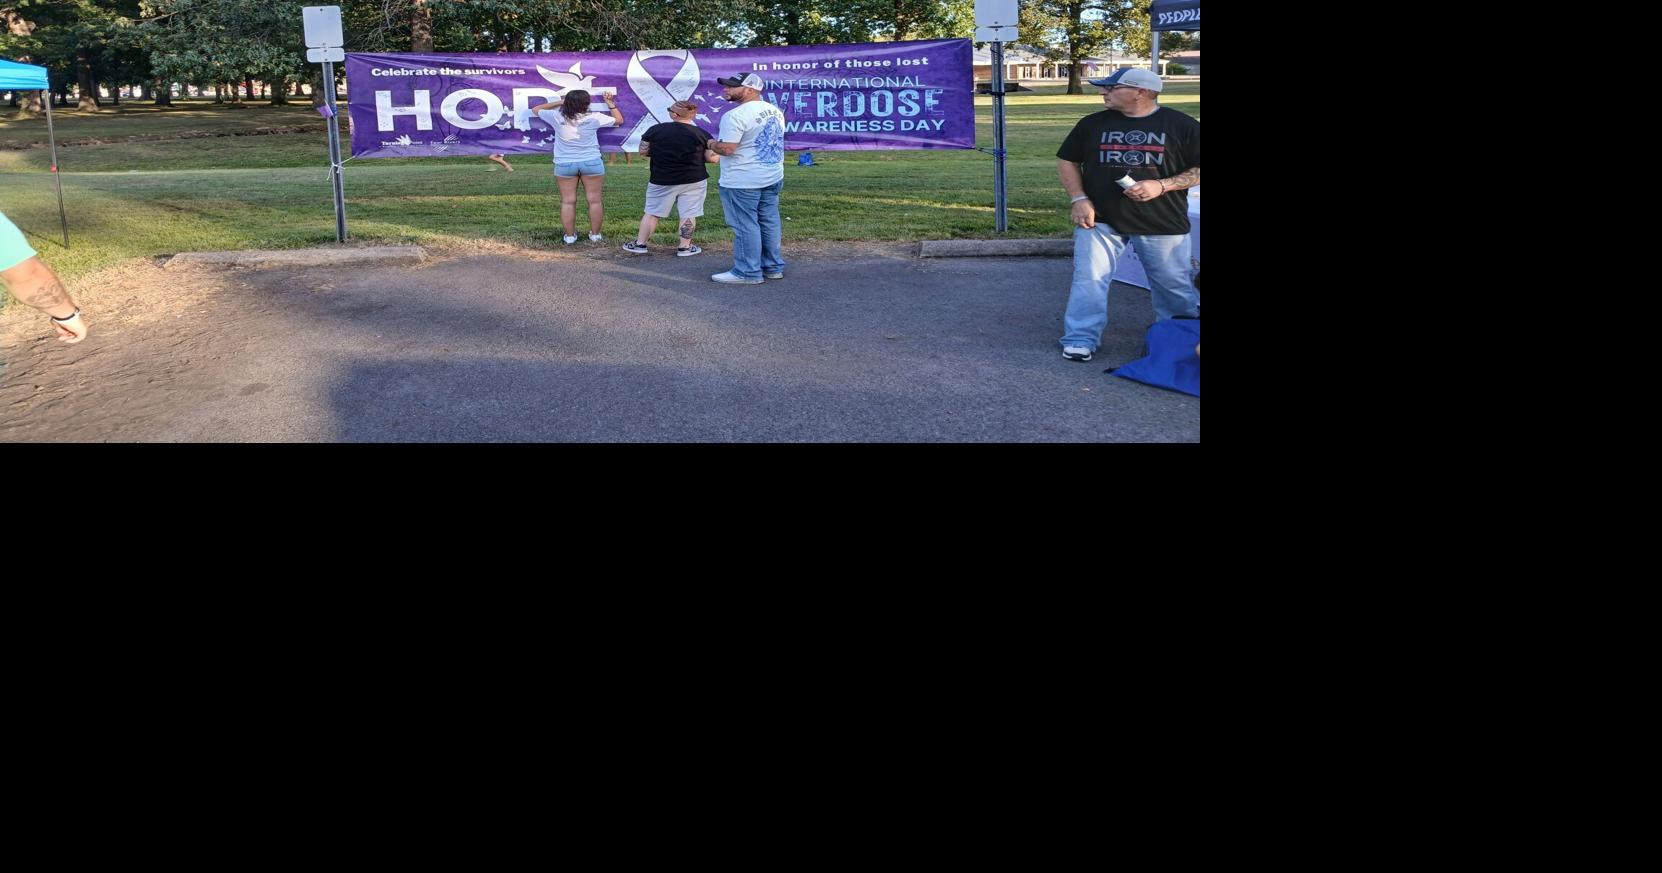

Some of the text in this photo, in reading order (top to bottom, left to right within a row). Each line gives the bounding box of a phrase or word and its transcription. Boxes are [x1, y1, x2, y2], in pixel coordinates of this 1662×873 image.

[753, 57, 928, 70] In honor of those lost
[371, 67, 525, 76] Celebrate the survivors
[765, 76, 926, 89] INTERNATIONAL
[760, 89, 944, 118] VERDOSE
[784, 119, 945, 133] WARENESS DAY
[1101, 130, 1166, 145] IRON
[1099, 150, 1164, 165] IRON
